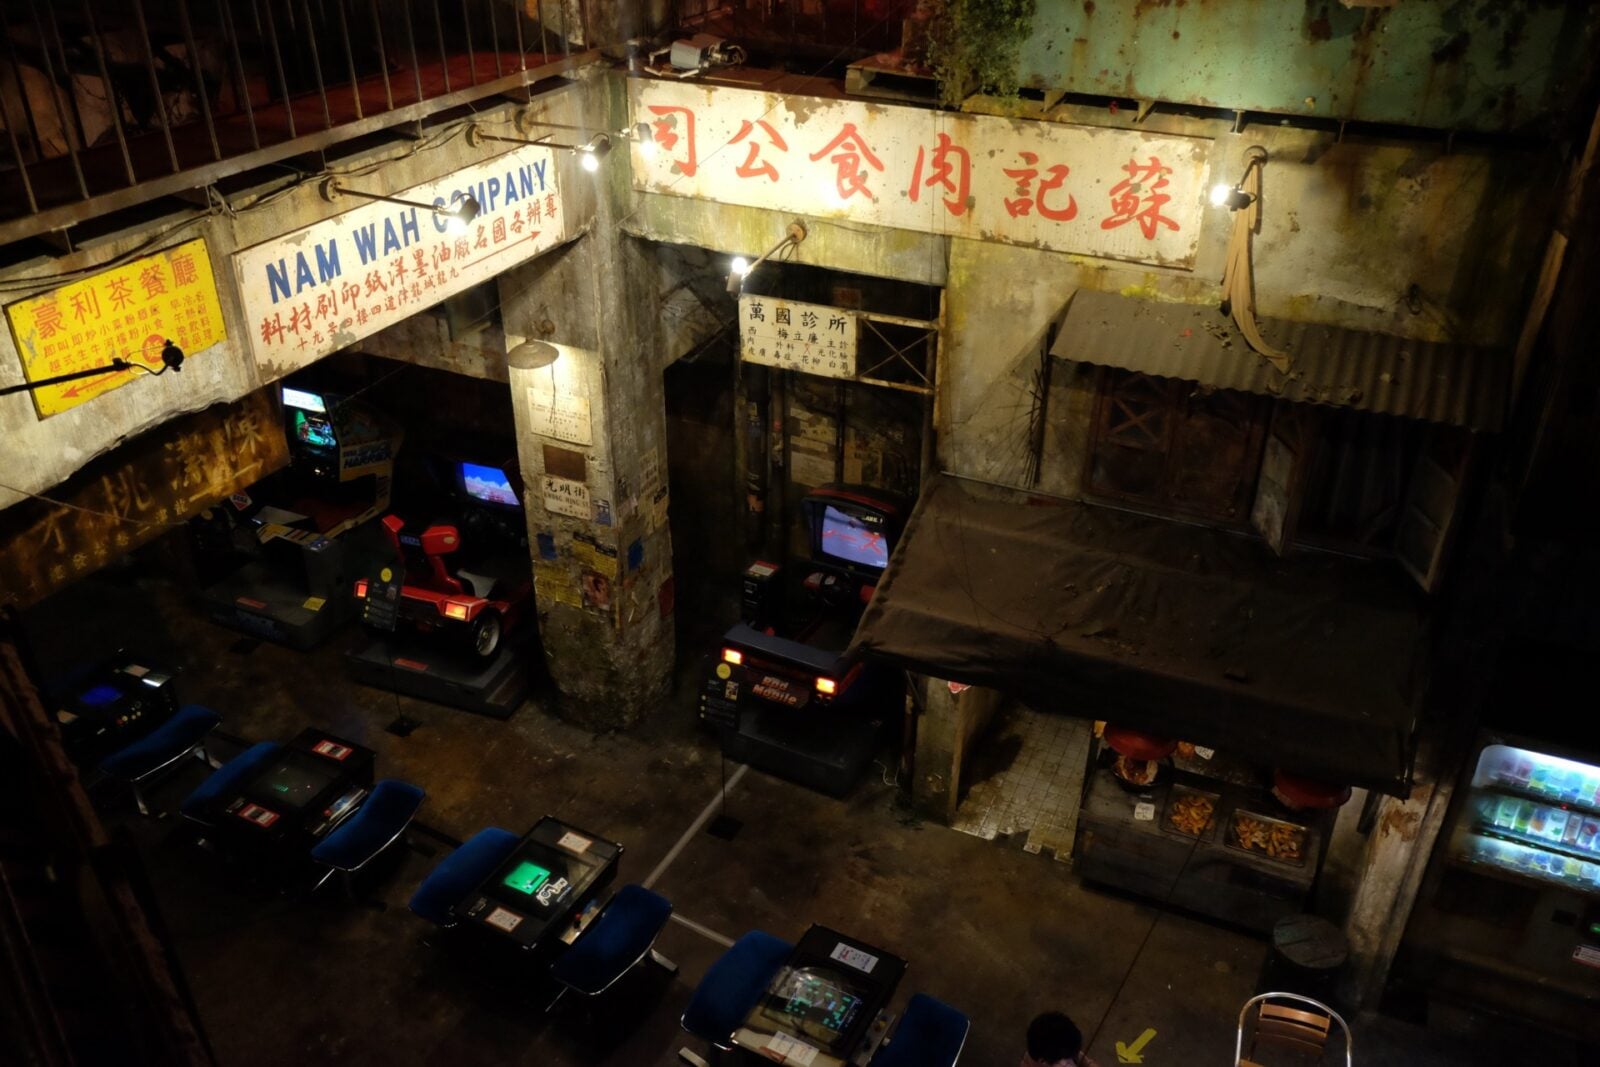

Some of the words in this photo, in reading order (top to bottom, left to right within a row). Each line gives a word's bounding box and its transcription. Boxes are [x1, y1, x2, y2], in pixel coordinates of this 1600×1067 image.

[647, 104, 1181, 241] 蘇記肉食公司
[30, 252, 199, 341] 豪利茶餐廳
[265, 238, 342, 305] NAM
[352, 206, 421, 266] WAH
[749, 302, 847, 335] 萬國診所
